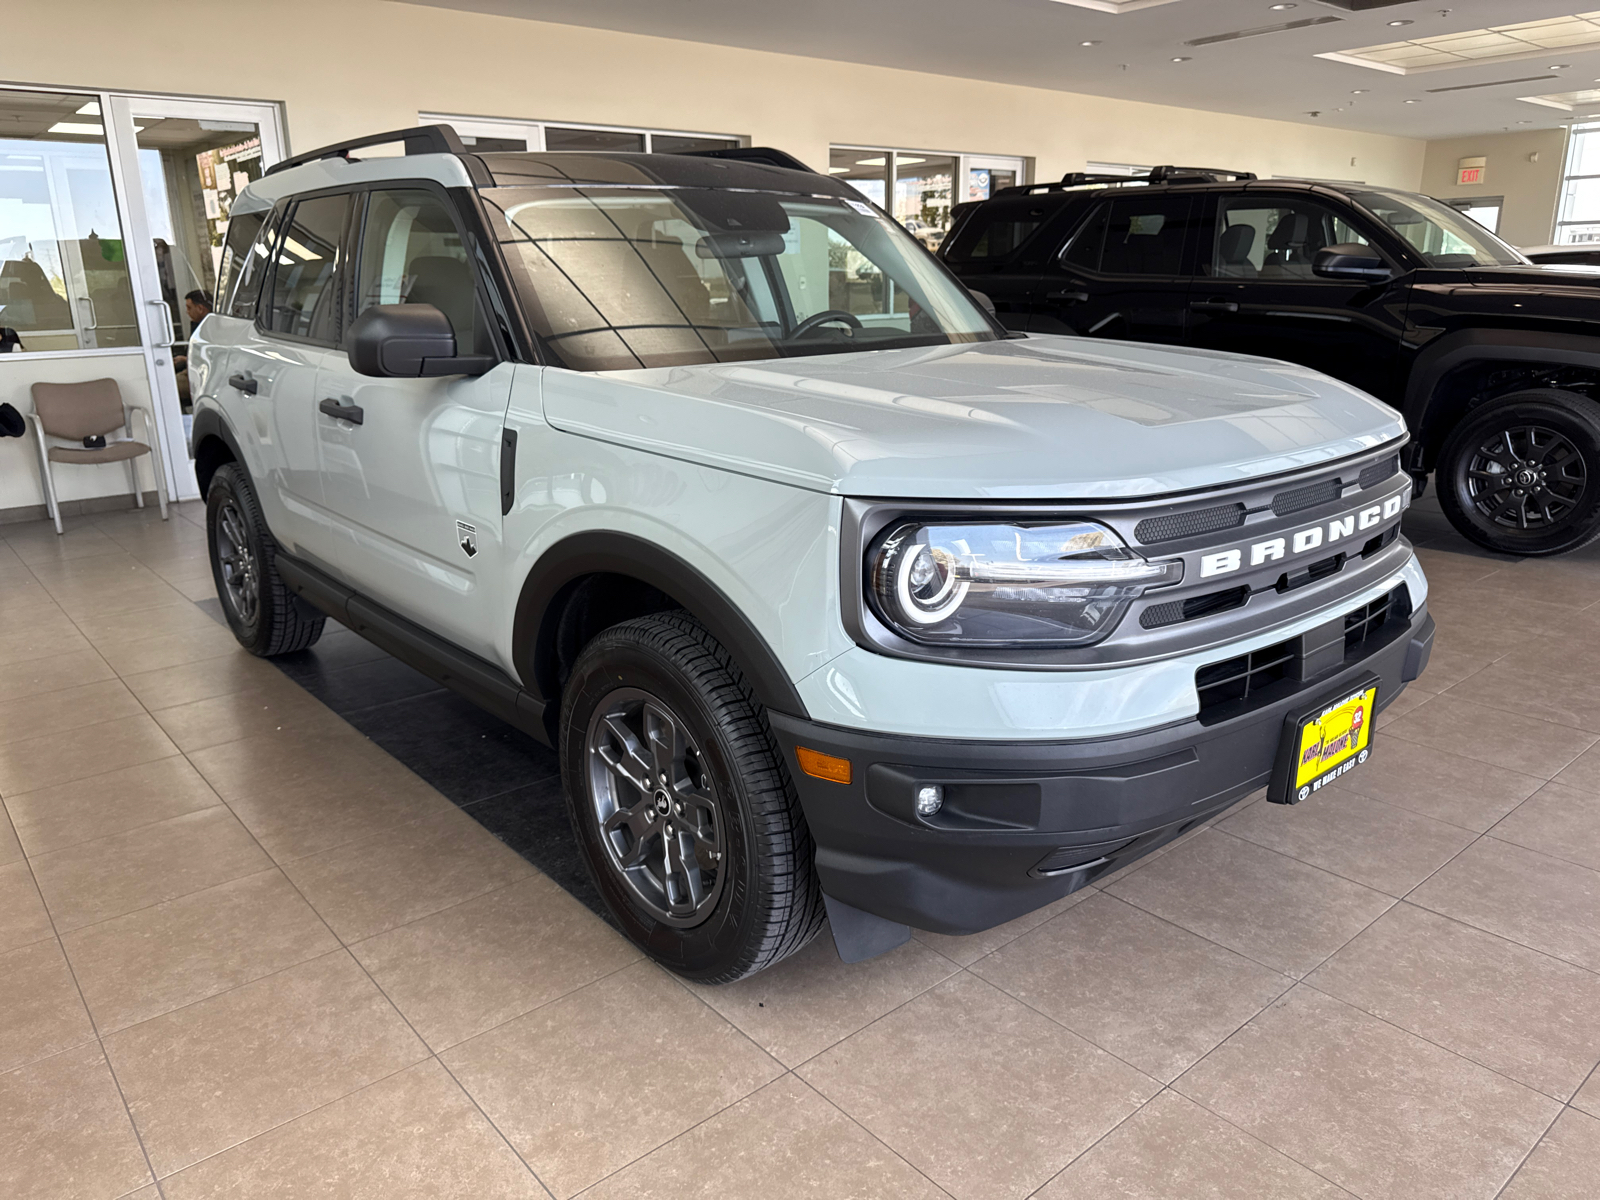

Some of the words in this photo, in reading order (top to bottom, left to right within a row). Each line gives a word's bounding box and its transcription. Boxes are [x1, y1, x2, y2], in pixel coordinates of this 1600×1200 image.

[1461, 169, 1480, 183] EXIT
[1200, 495, 1401, 578] BRONCO
[1354, 711, 1362, 724] 32
[1301, 741, 1321, 766] KARL
[1321, 733, 1349, 763] MALONE
[1313, 778, 1322, 791] WE
[1322, 769, 1337, 786] MAKE
[1337, 765, 1343, 777] IT
[1343, 758, 1355, 773] EASY
